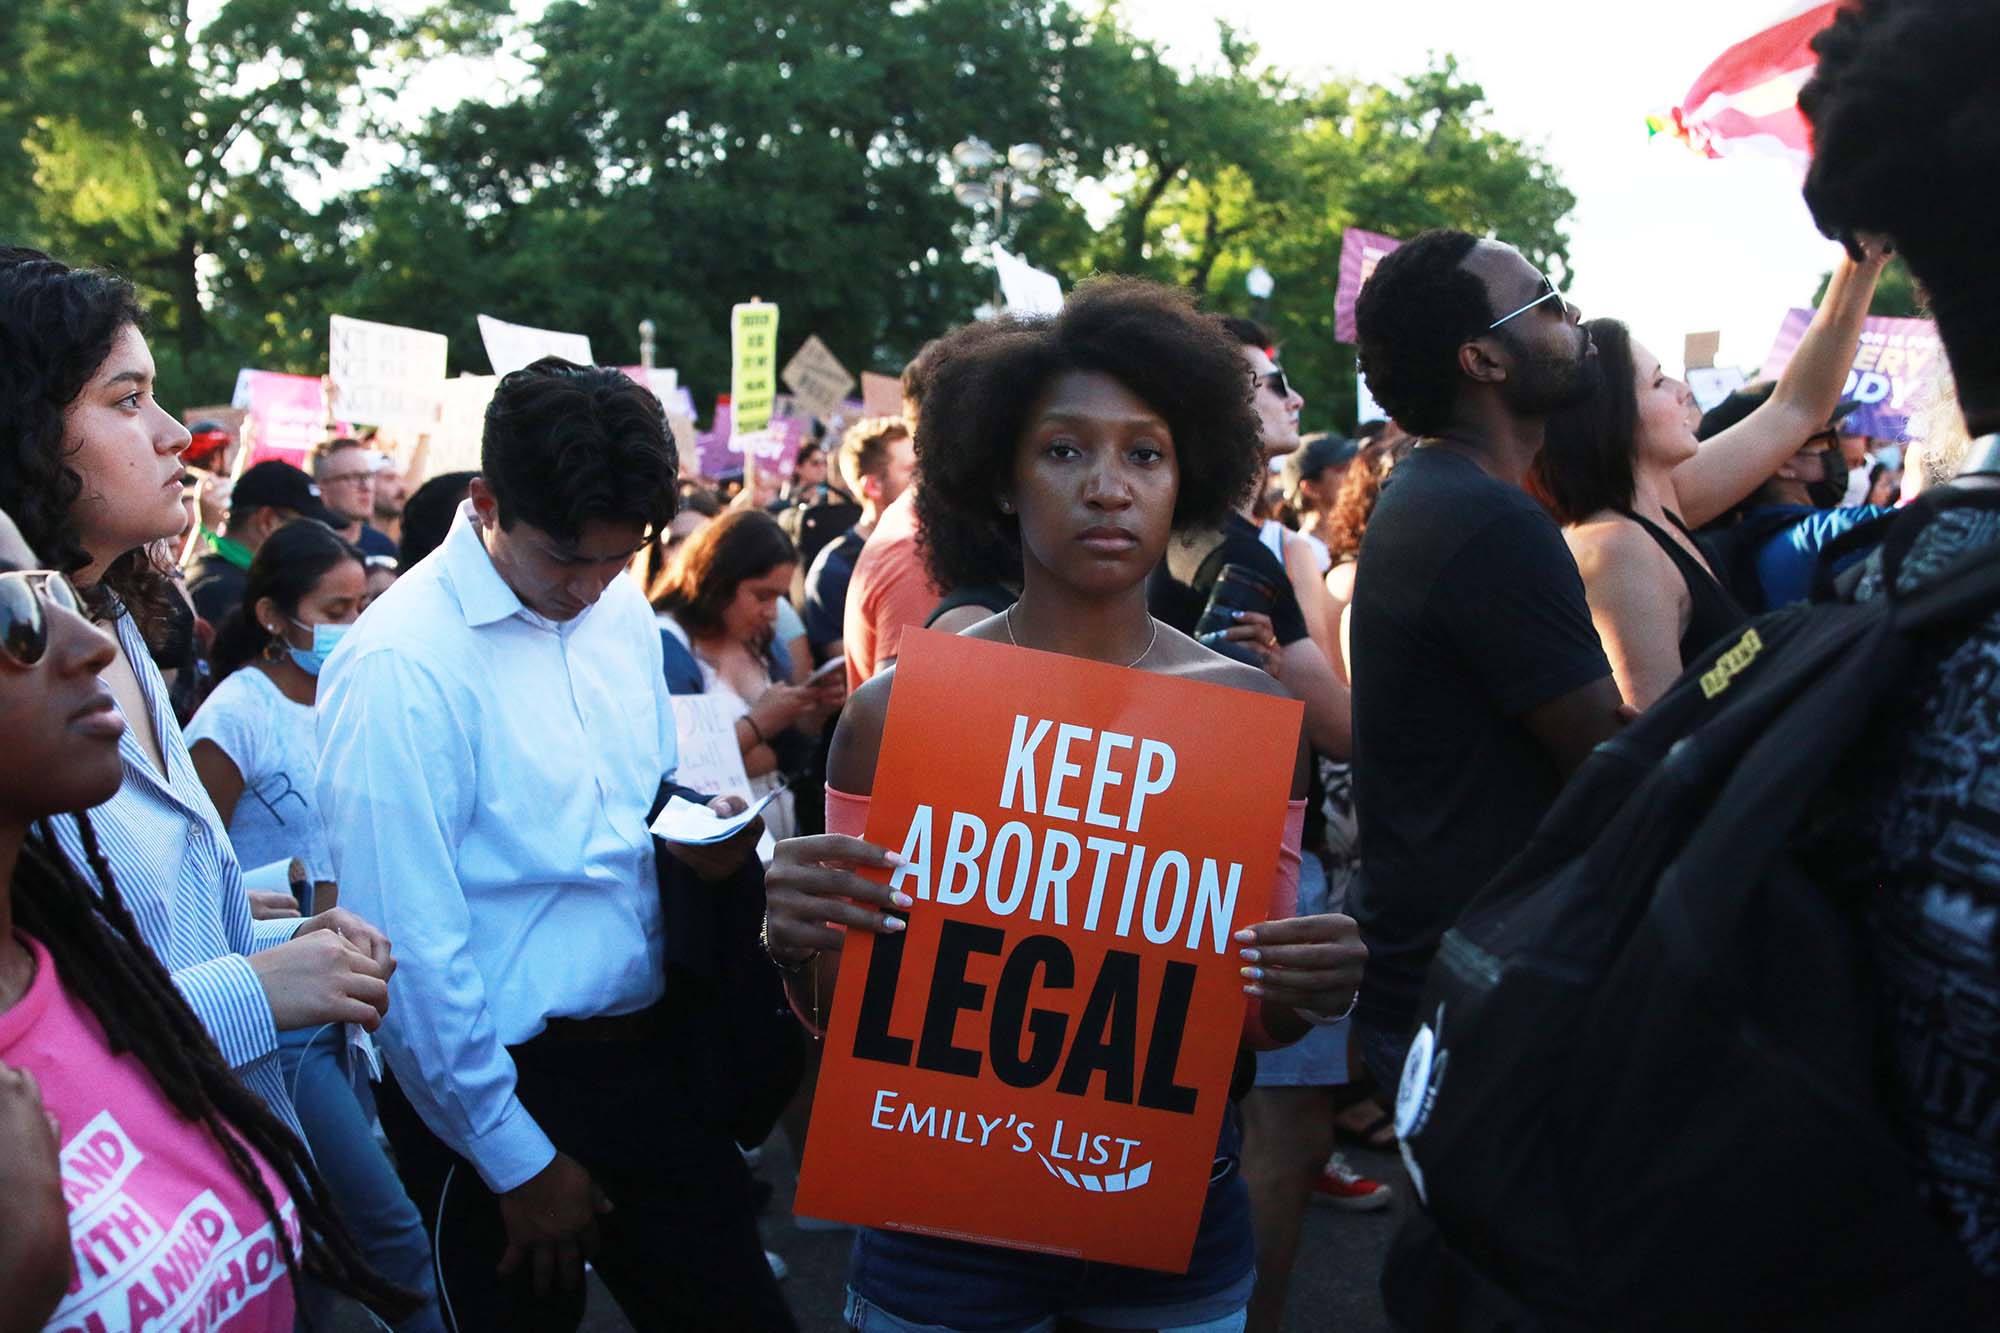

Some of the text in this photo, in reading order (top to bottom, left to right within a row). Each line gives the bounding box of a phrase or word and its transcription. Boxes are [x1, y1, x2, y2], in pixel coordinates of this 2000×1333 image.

[1853, 344, 1934, 378] ERY
[999, 714, 1177, 833] KEEP
[888, 804, 1243, 955] ABORTION
[852, 907, 1199, 1116] LEGAL
[63, 1130, 125, 1212] AND
[1050, 1119, 1141, 1169] LIST
[60, 1202, 152, 1295] ITH
